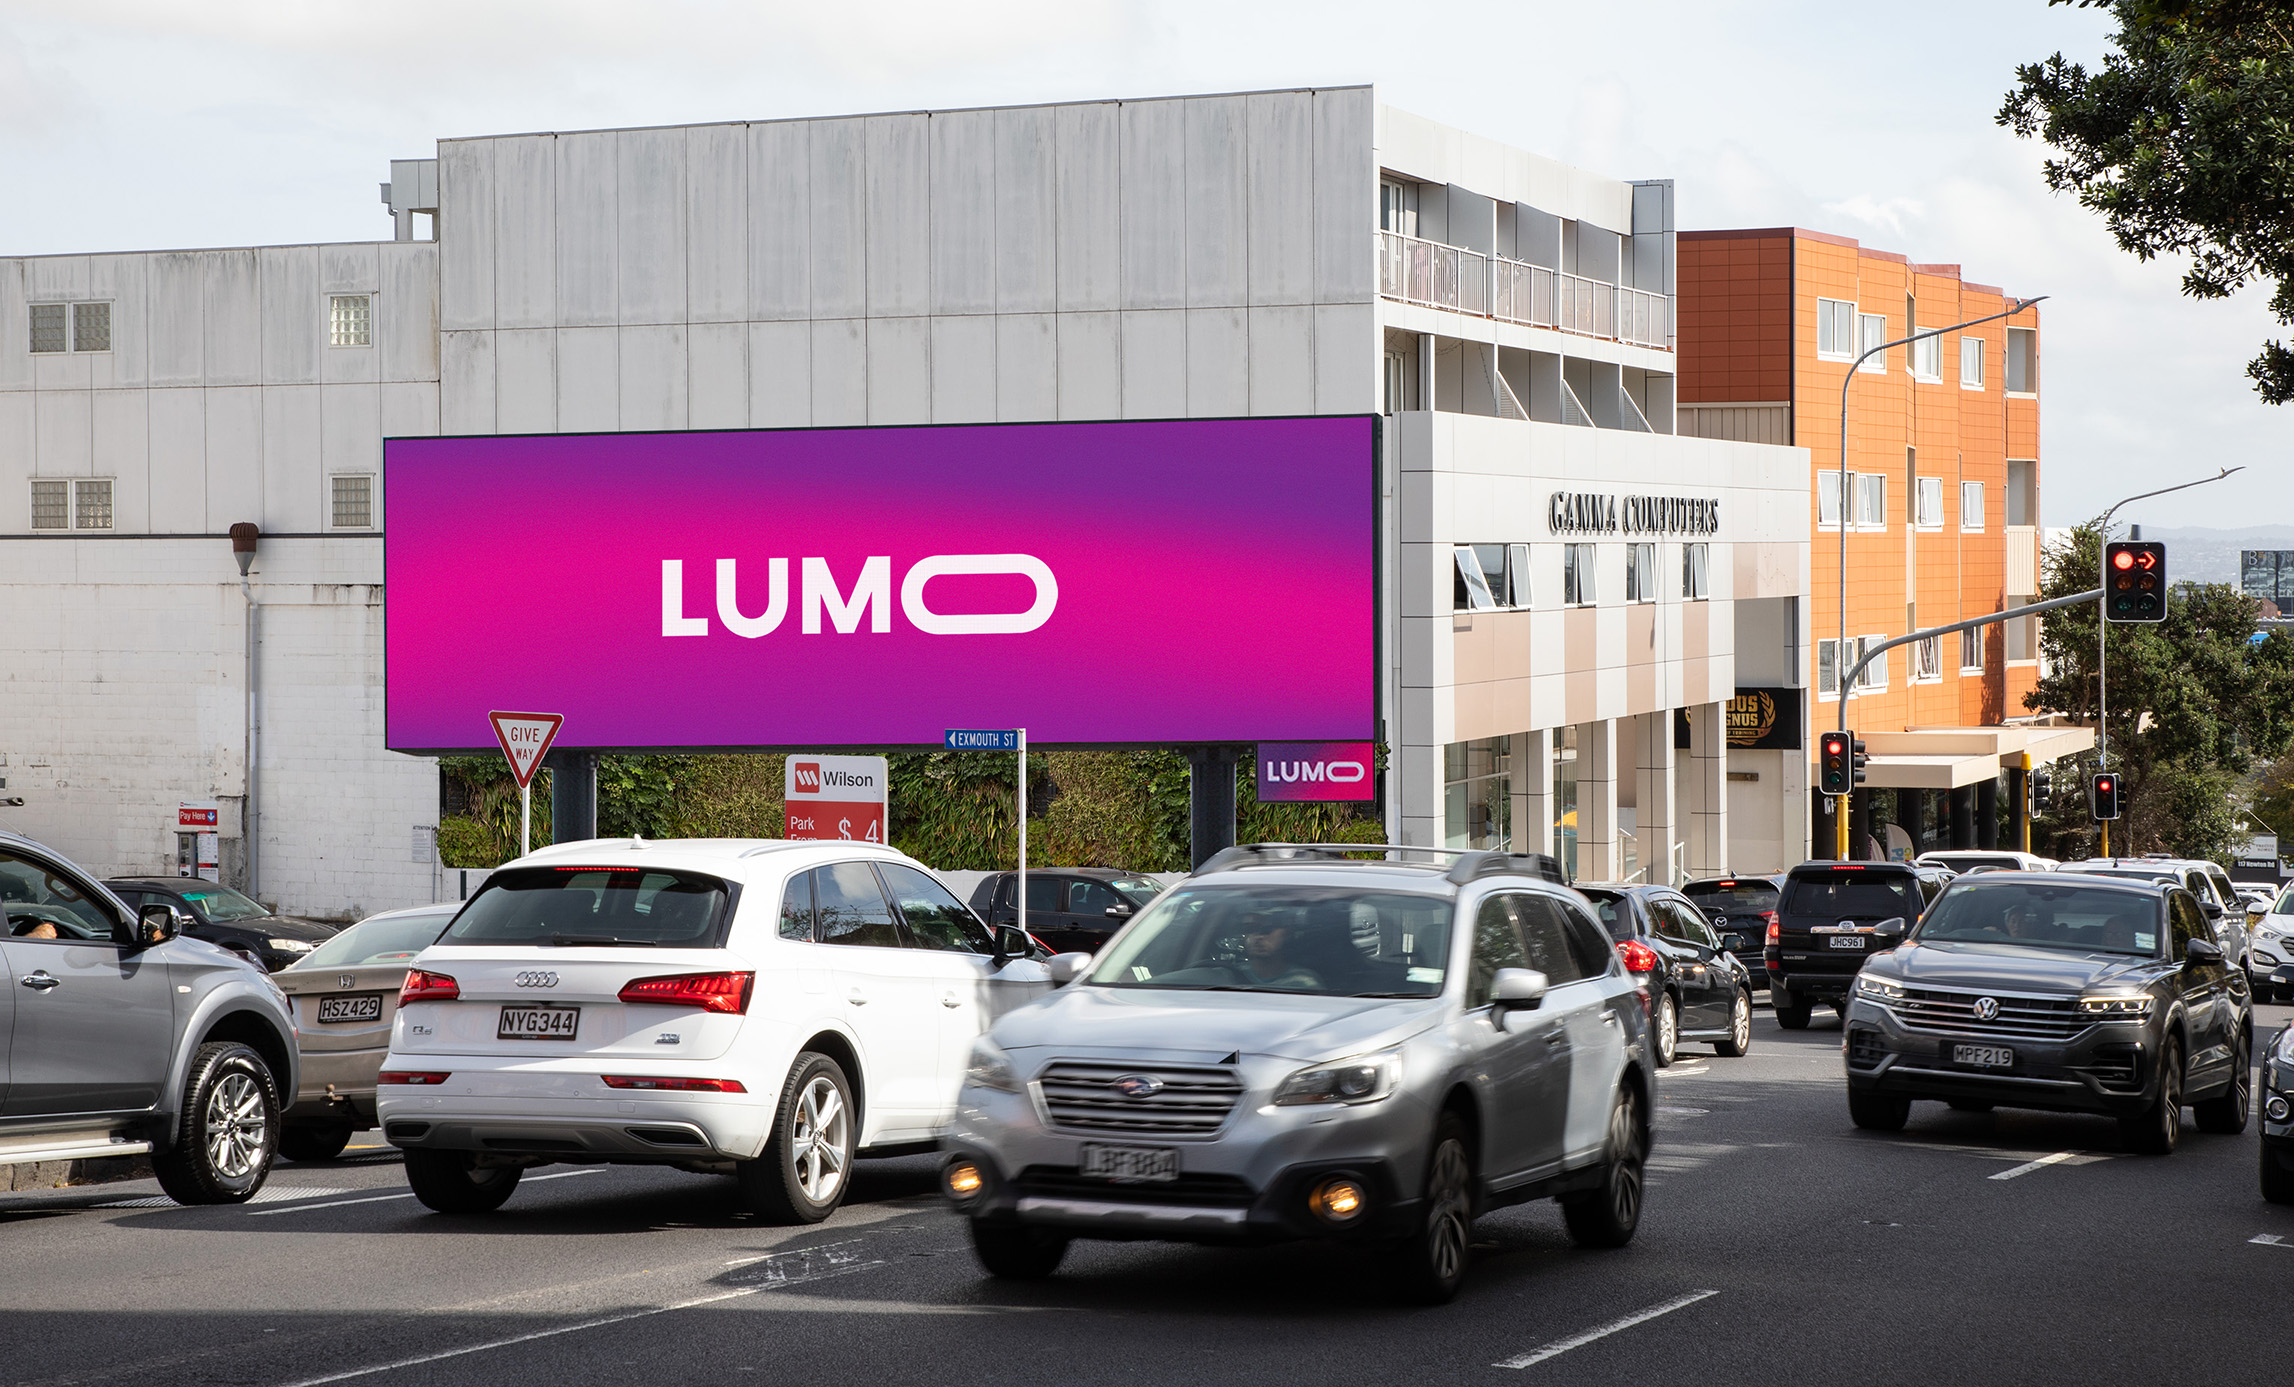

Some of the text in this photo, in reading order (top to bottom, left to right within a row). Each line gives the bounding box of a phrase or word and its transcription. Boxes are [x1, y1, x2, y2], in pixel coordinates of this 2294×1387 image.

[1549, 491, 1719, 537] GAMMA COMPUTERS
[662, 554, 1058, 638] LUMO
[1726, 695, 1758, 712] DUS
[1726, 713, 1758, 726] GNUS
[511, 727, 540, 742] GIVE
[958, 733, 1014, 746] EXMOUTH ST
[516, 748, 534, 760] WAY
[823, 771, 873, 787] Wilson
[1267, 761, 1365, 782] LUMO
[180, 811, 206, 821] Pay Here
[790, 816, 815, 831] Park
[1831, 937, 1863, 947] JHC961
[322, 1000, 378, 1017] HSZ429
[503, 1012, 573, 1032] NYG344
[1955, 1047, 2012, 1064] MPF219
